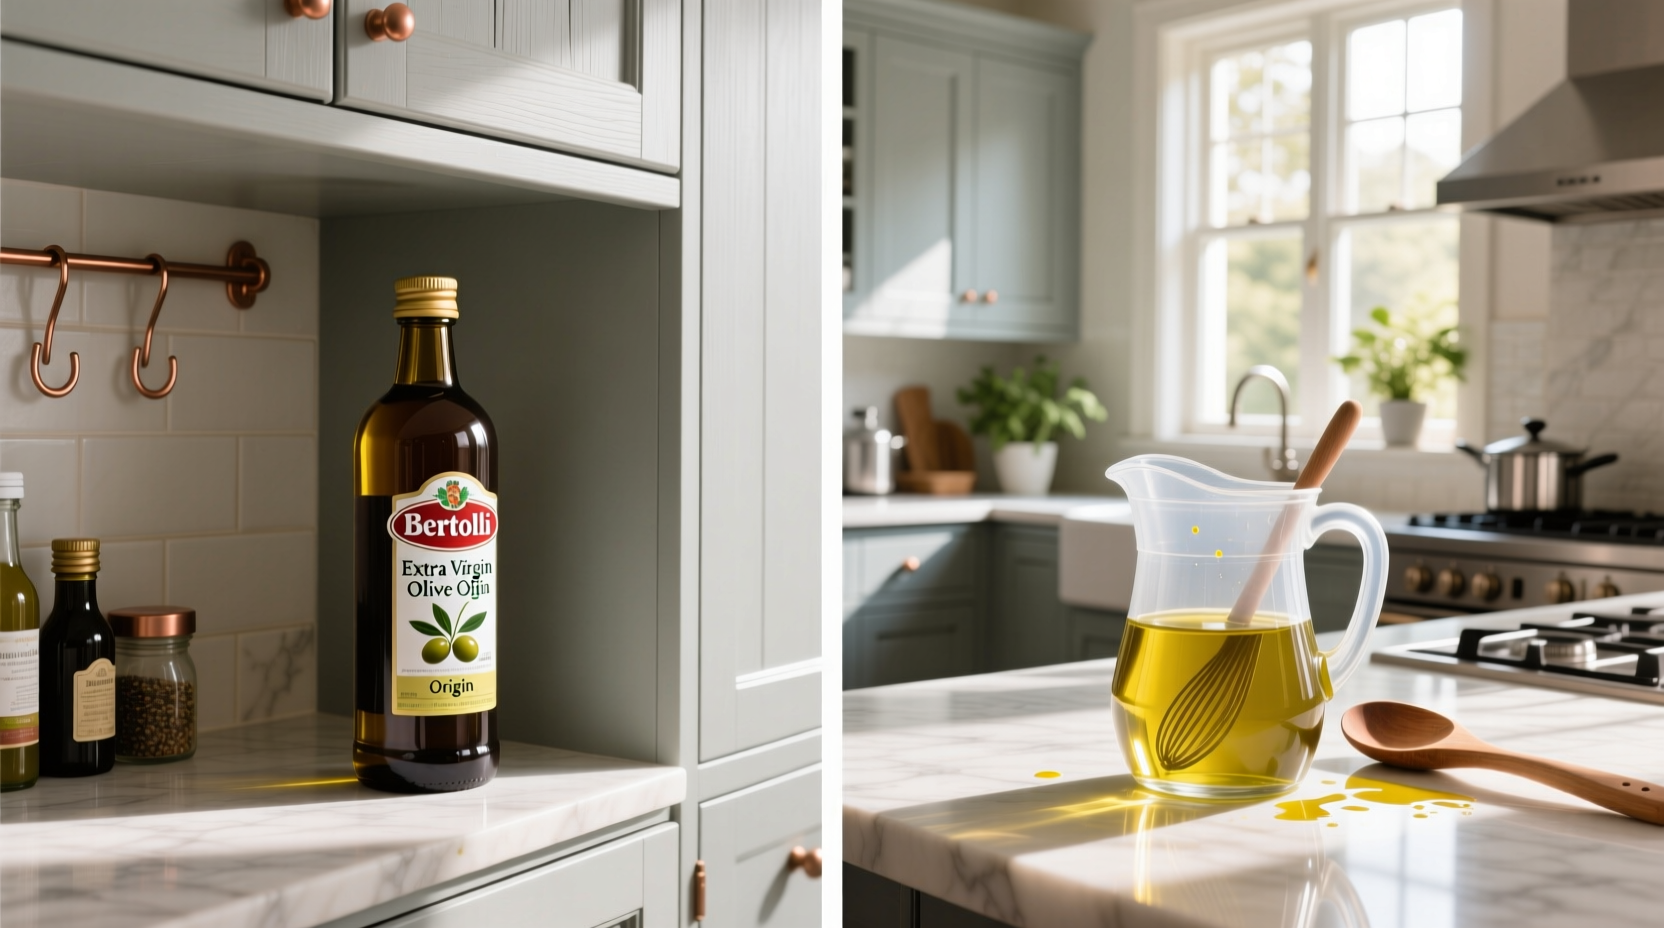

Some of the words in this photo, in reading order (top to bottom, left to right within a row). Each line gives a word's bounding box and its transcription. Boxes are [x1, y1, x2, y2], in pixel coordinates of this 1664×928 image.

[404, 512, 491, 537] Bertolli
[402, 560, 447, 577] Extra
[450, 559, 492, 578] Virgin
[407, 580, 453, 598] Olive
[429, 678, 474, 698] Origin
